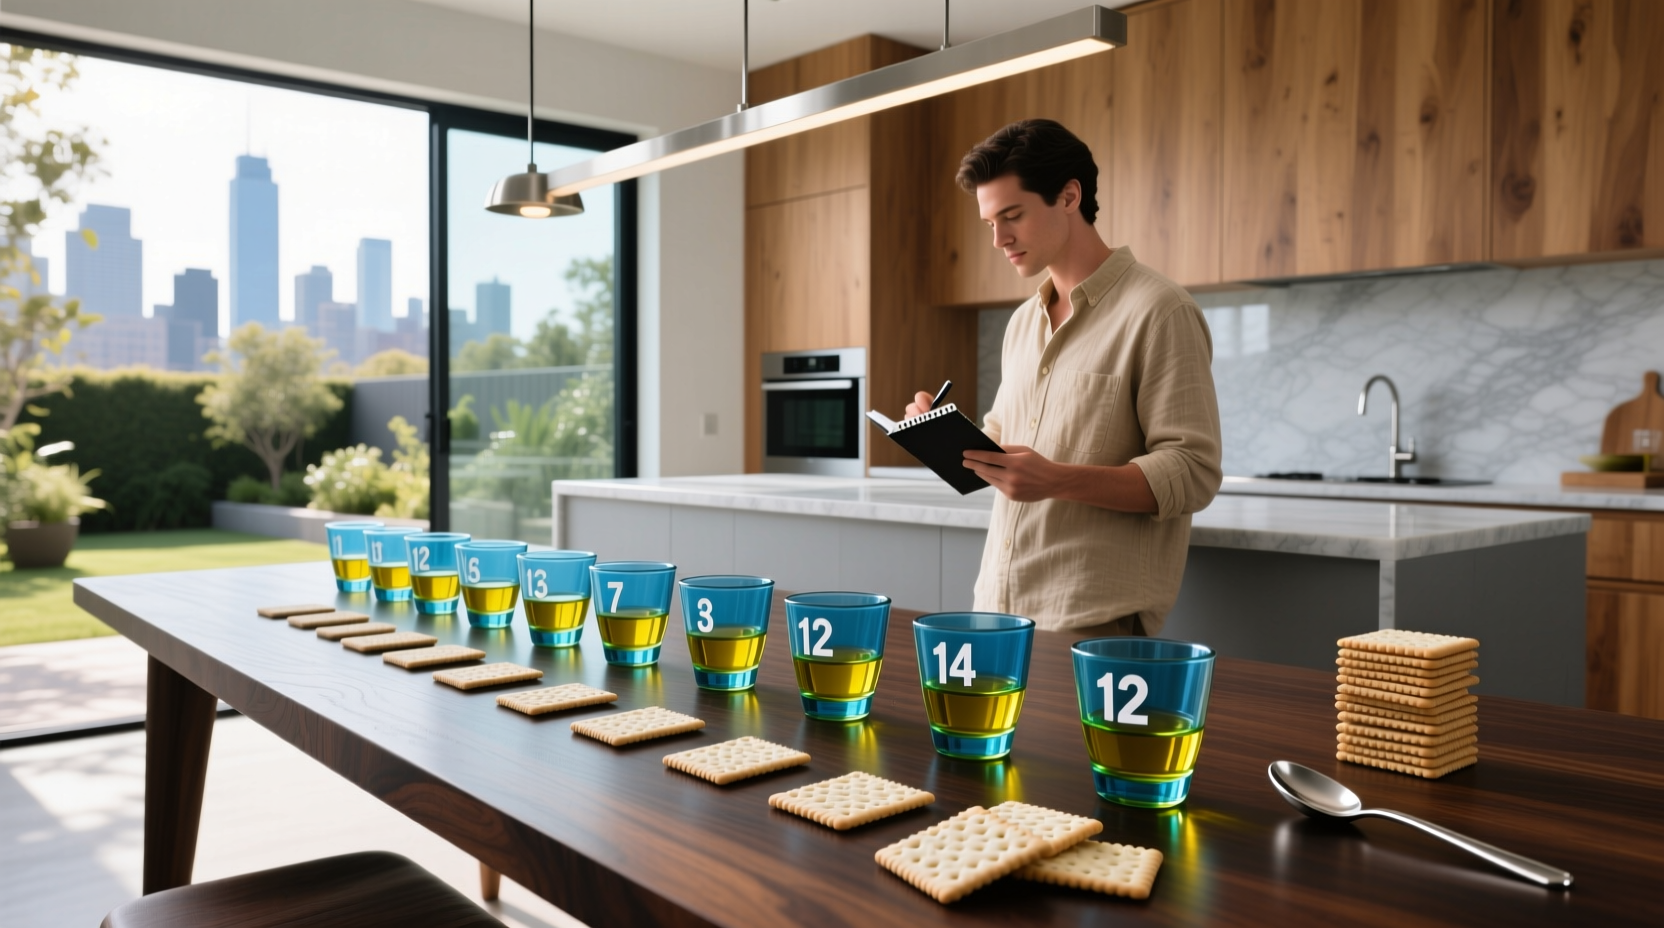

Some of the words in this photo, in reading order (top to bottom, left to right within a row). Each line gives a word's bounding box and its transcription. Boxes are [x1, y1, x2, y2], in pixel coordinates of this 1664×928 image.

[413, 546, 430, 571] 12
[527, 568, 548, 599] 13
[607, 581, 623, 613] 7
[697, 598, 714, 633] 3
[799, 617, 833, 657] 12
[933, 642, 976, 687] 14
[1097, 672, 1149, 726] 12
